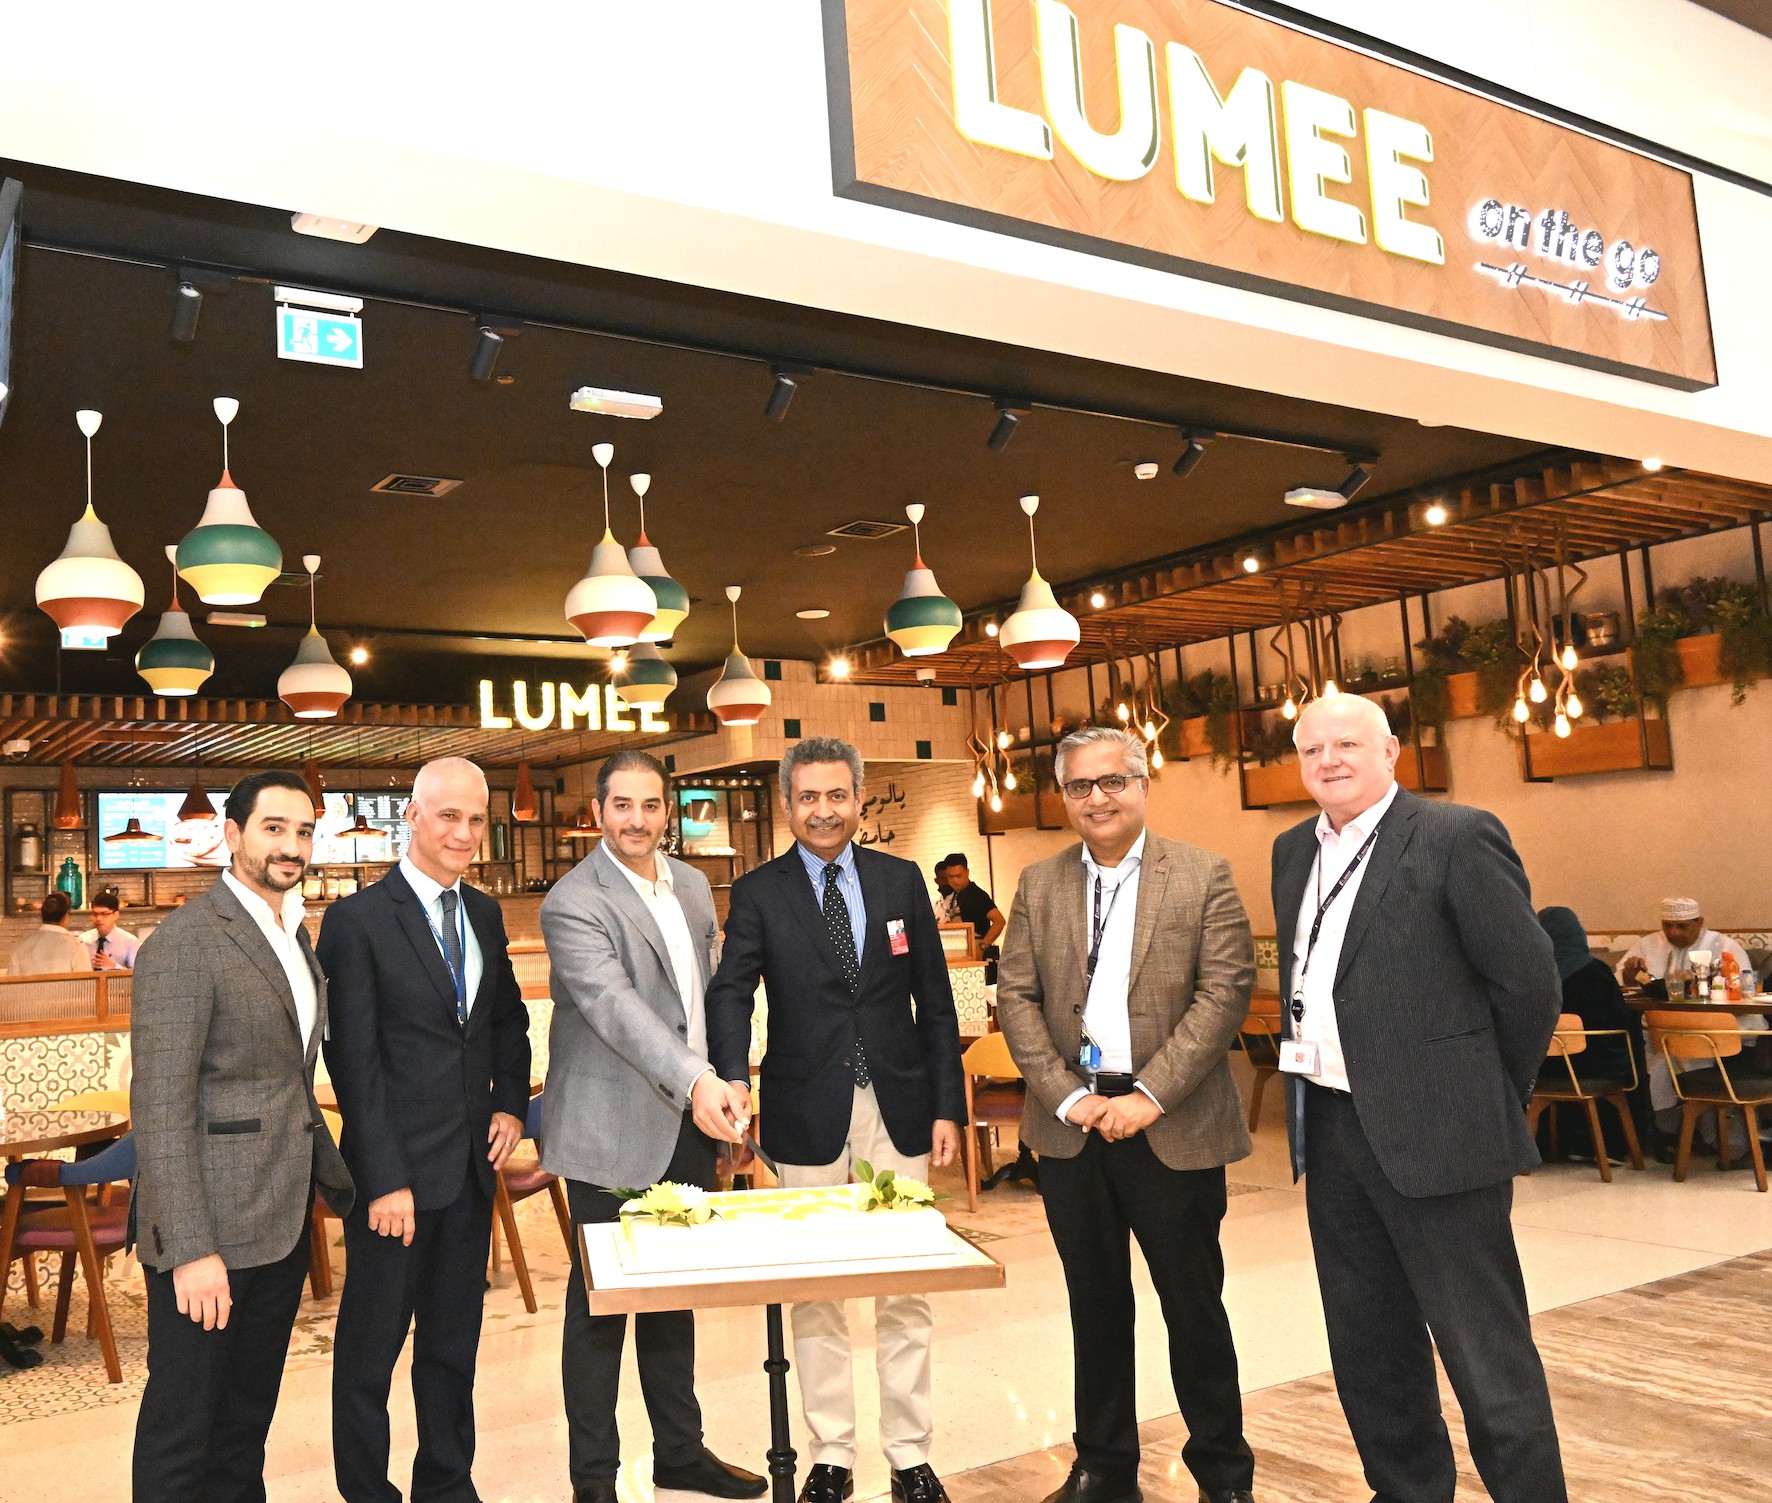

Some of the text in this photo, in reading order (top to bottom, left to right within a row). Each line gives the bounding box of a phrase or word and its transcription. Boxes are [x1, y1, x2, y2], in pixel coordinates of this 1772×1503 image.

[948, 0, 1445, 264] LUMEE
[1479, 199, 1661, 289] on the go
